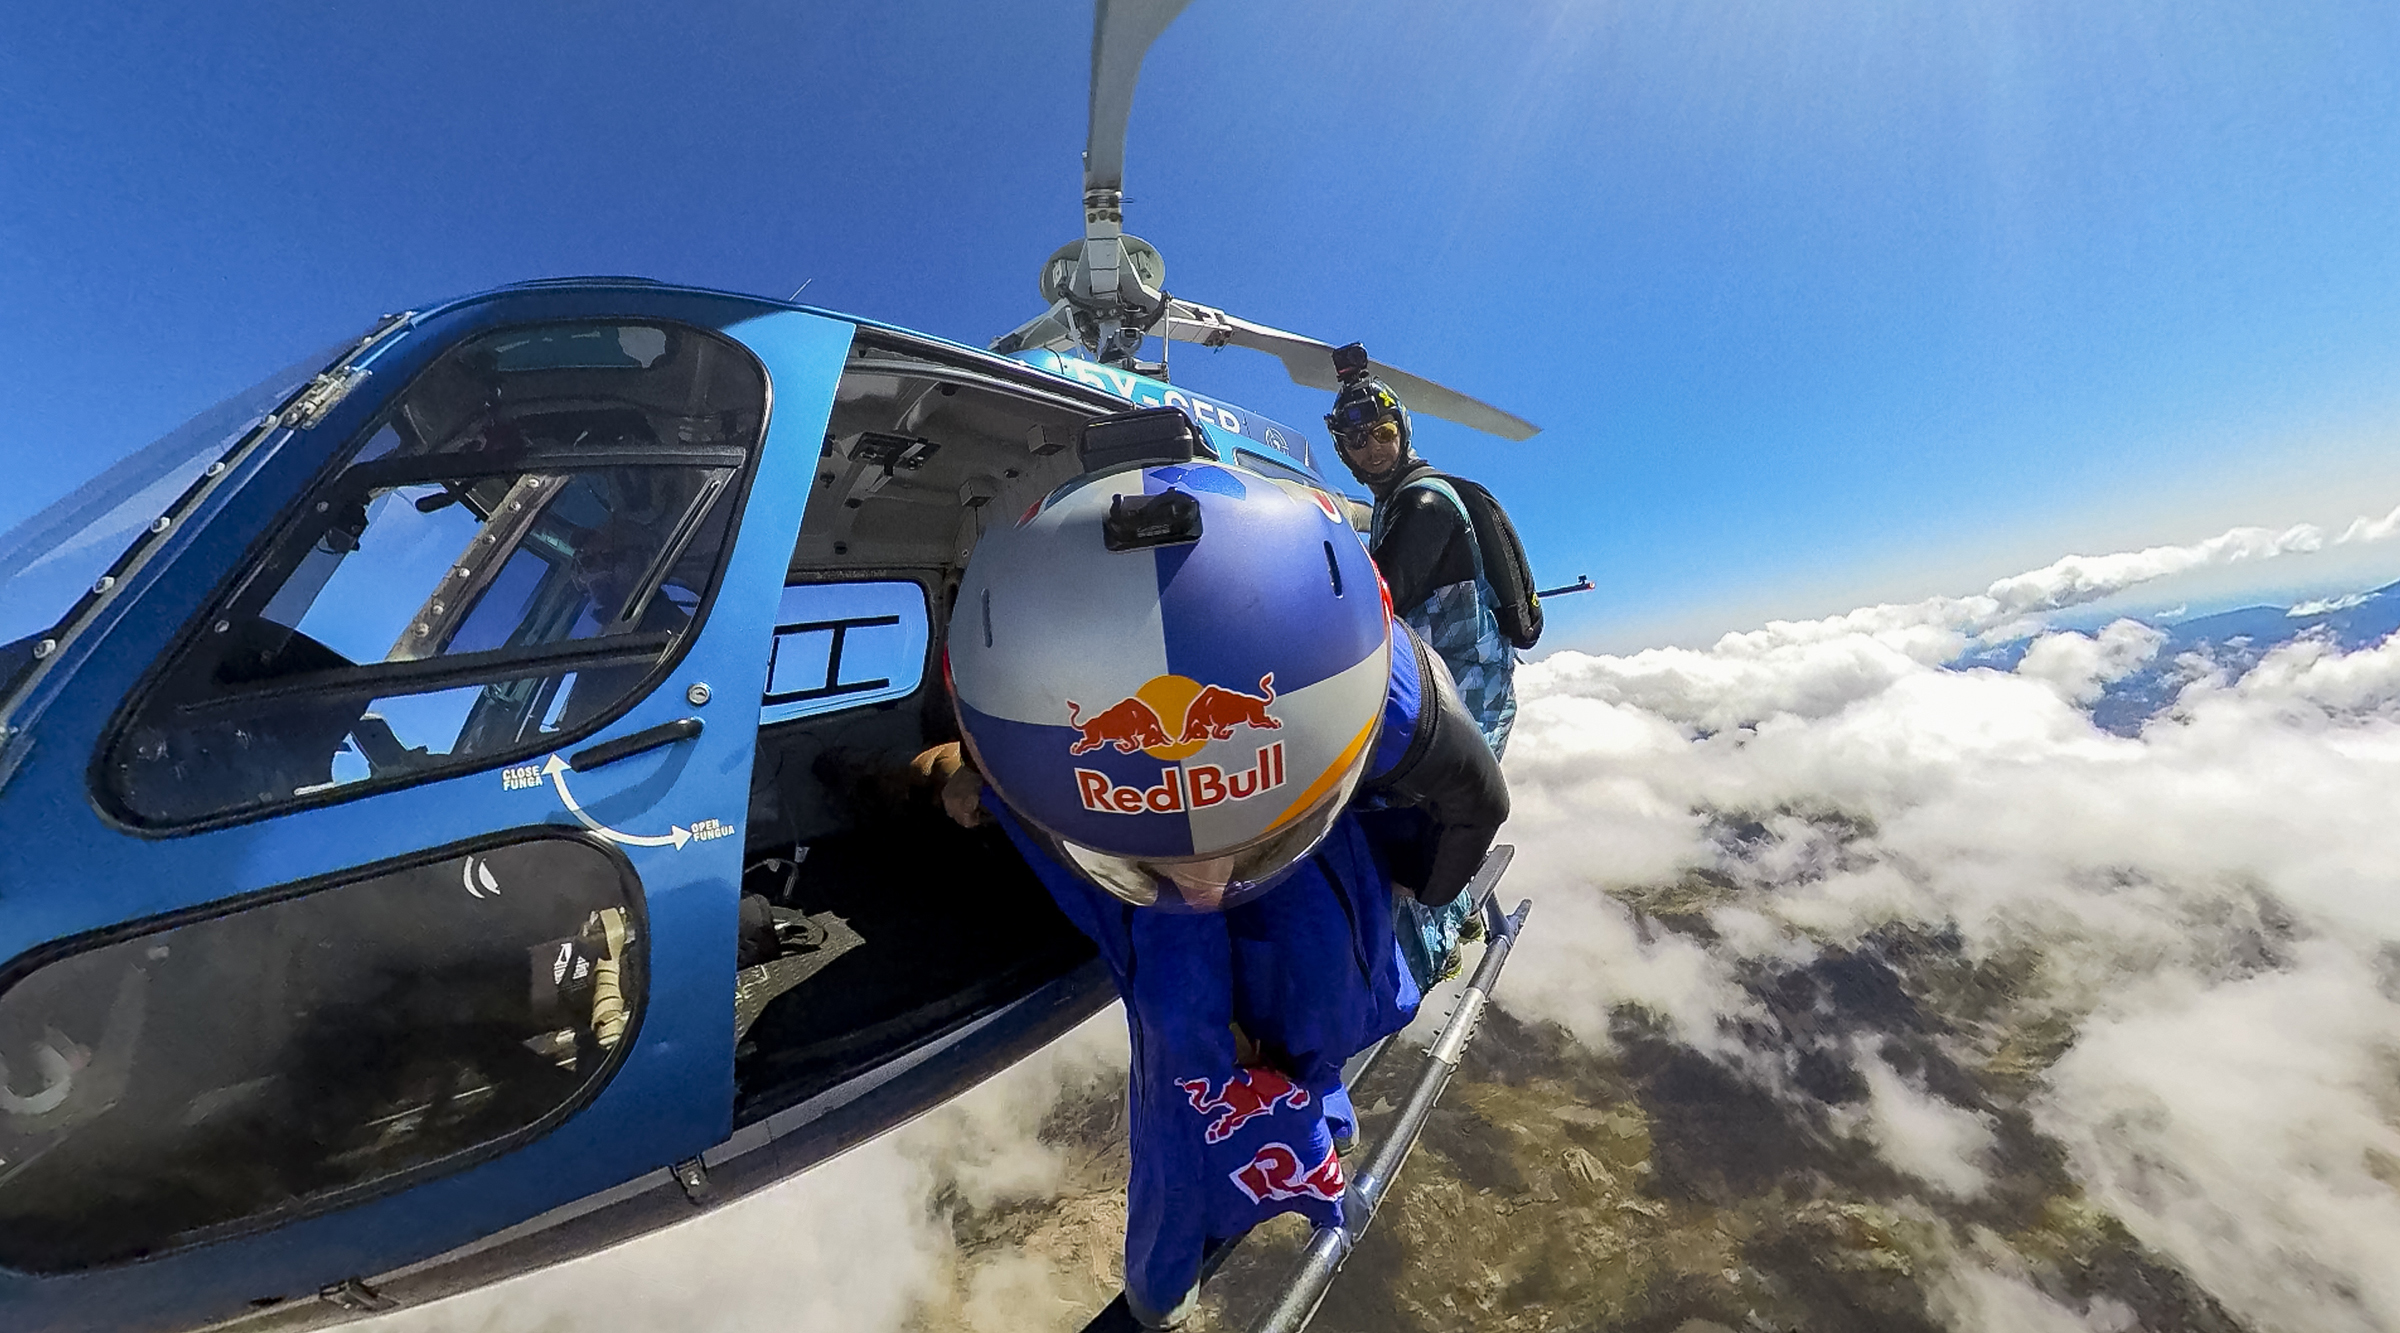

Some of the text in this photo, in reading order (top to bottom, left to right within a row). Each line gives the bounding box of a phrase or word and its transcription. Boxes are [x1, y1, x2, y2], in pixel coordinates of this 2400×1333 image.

[502, 765, 540, 780] CLOSE
[1075, 740, 1286, 814] Red Bull
[503, 776, 543, 791] FUNGA
[690, 819, 719, 833] OPEN
[693, 825, 735, 842] FUNGUA
